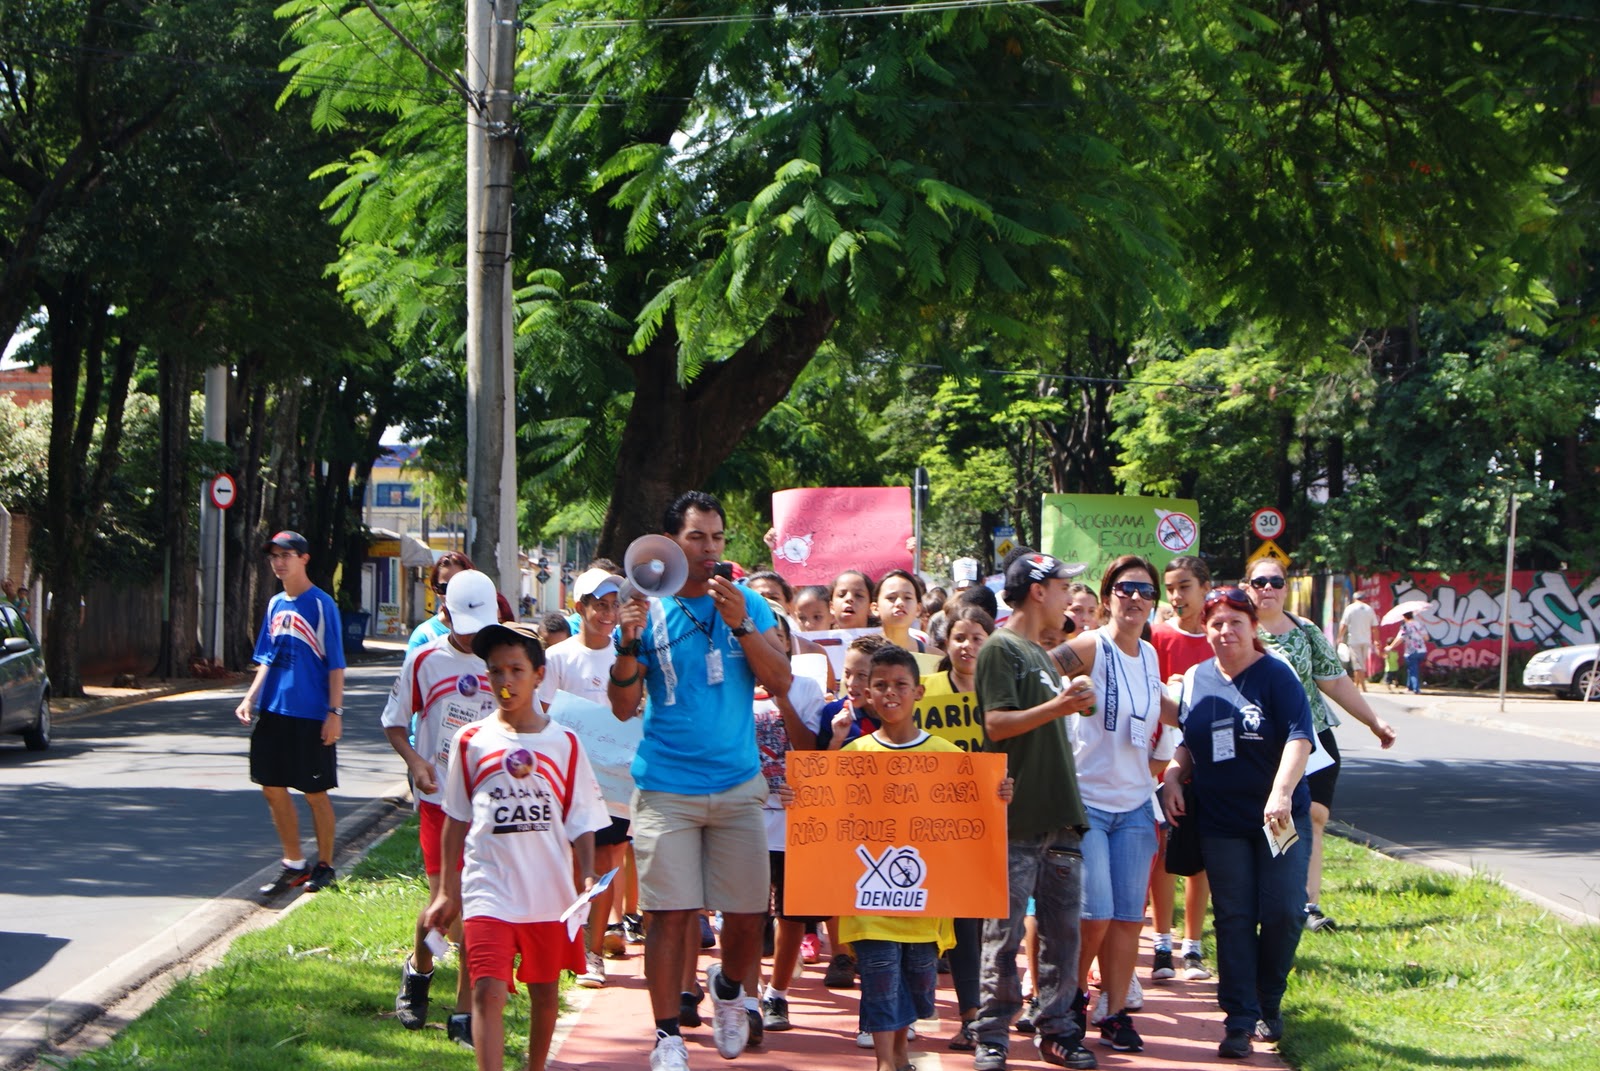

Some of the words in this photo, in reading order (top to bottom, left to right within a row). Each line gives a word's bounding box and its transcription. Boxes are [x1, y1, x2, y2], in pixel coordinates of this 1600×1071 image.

[1051, 502, 1146, 530] PROGRAMA
[1260, 515, 1278, 526] 30
[1098, 530, 1157, 549] ESCOLA
[1105, 695, 1117, 729] EDUCADOR
[792, 753, 829, 778] NÃO
[835, 755, 878, 778] FAÇA
[887, 755, 938, 775] COMO
[957, 755, 974, 775] A
[845, 783, 872, 805] DA
[883, 783, 919, 804] SUA
[929, 781, 980, 804] CASA
[494, 805, 551, 824] CASE
[790, 816, 828, 846] NÃO
[909, 817, 985, 841] PARADO
[861, 890, 924, 909] DENGUE
